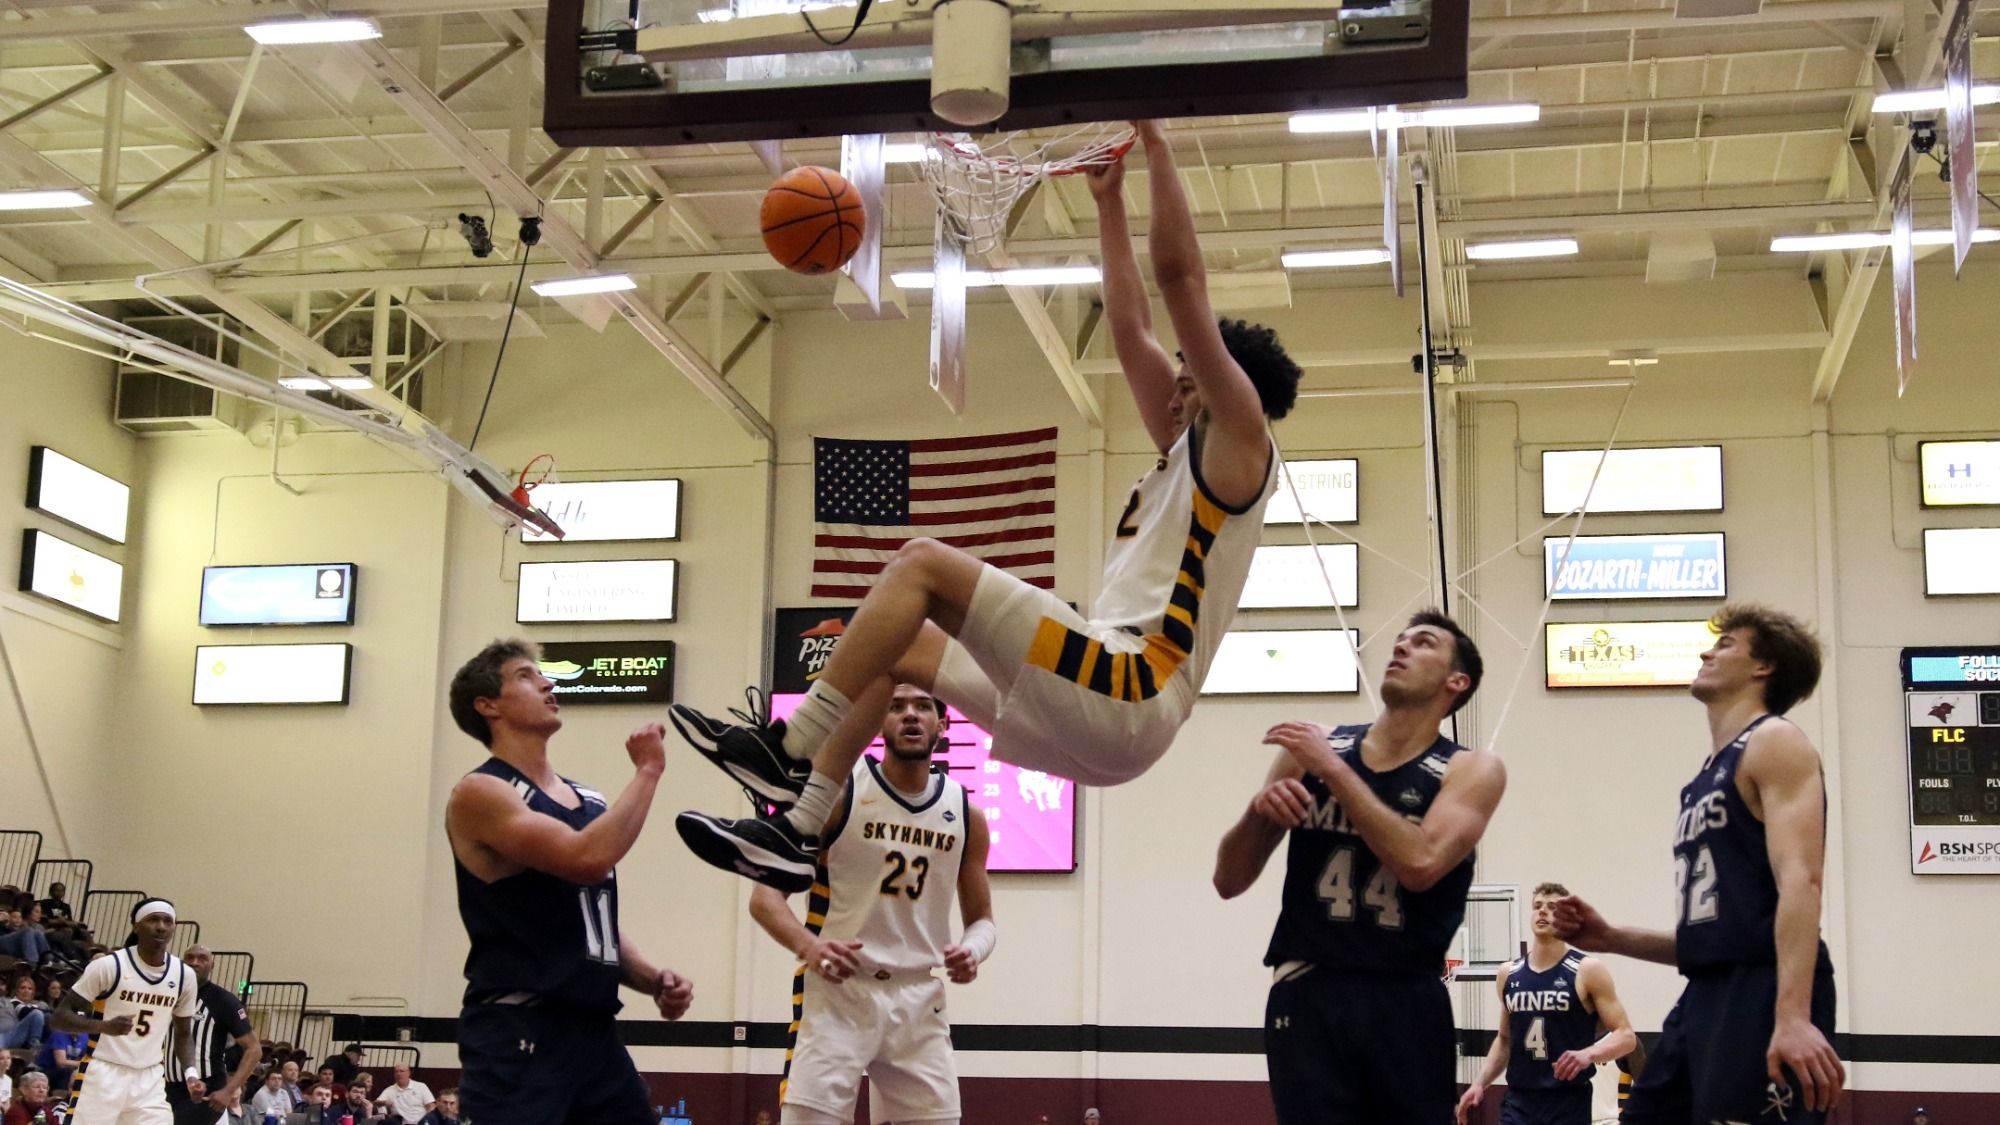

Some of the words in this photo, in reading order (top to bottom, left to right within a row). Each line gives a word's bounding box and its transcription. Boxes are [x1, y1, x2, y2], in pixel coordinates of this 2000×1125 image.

[1298, 473, 1352, 489] STRING
[1555, 558, 1718, 591] BOZARTH-MILLER
[1571, 645, 1633, 661] TEXAS
[587, 658, 618, 670] JET
[621, 657, 667, 670] BOAT
[1932, 728, 1965, 743] FLC
[1919, 778, 1949, 788] FOULS
[863, 822, 956, 852] SKYHAWKS
[1940, 843, 1974, 855] BSN
[879, 850, 929, 901] 23
[1315, 845, 1405, 931] 44
[119, 990, 175, 1008] SKYHAWKS
[1505, 990, 1570, 1013] MINES
[135, 1009, 153, 1037] 5
[1524, 1016, 1548, 1060] 4
